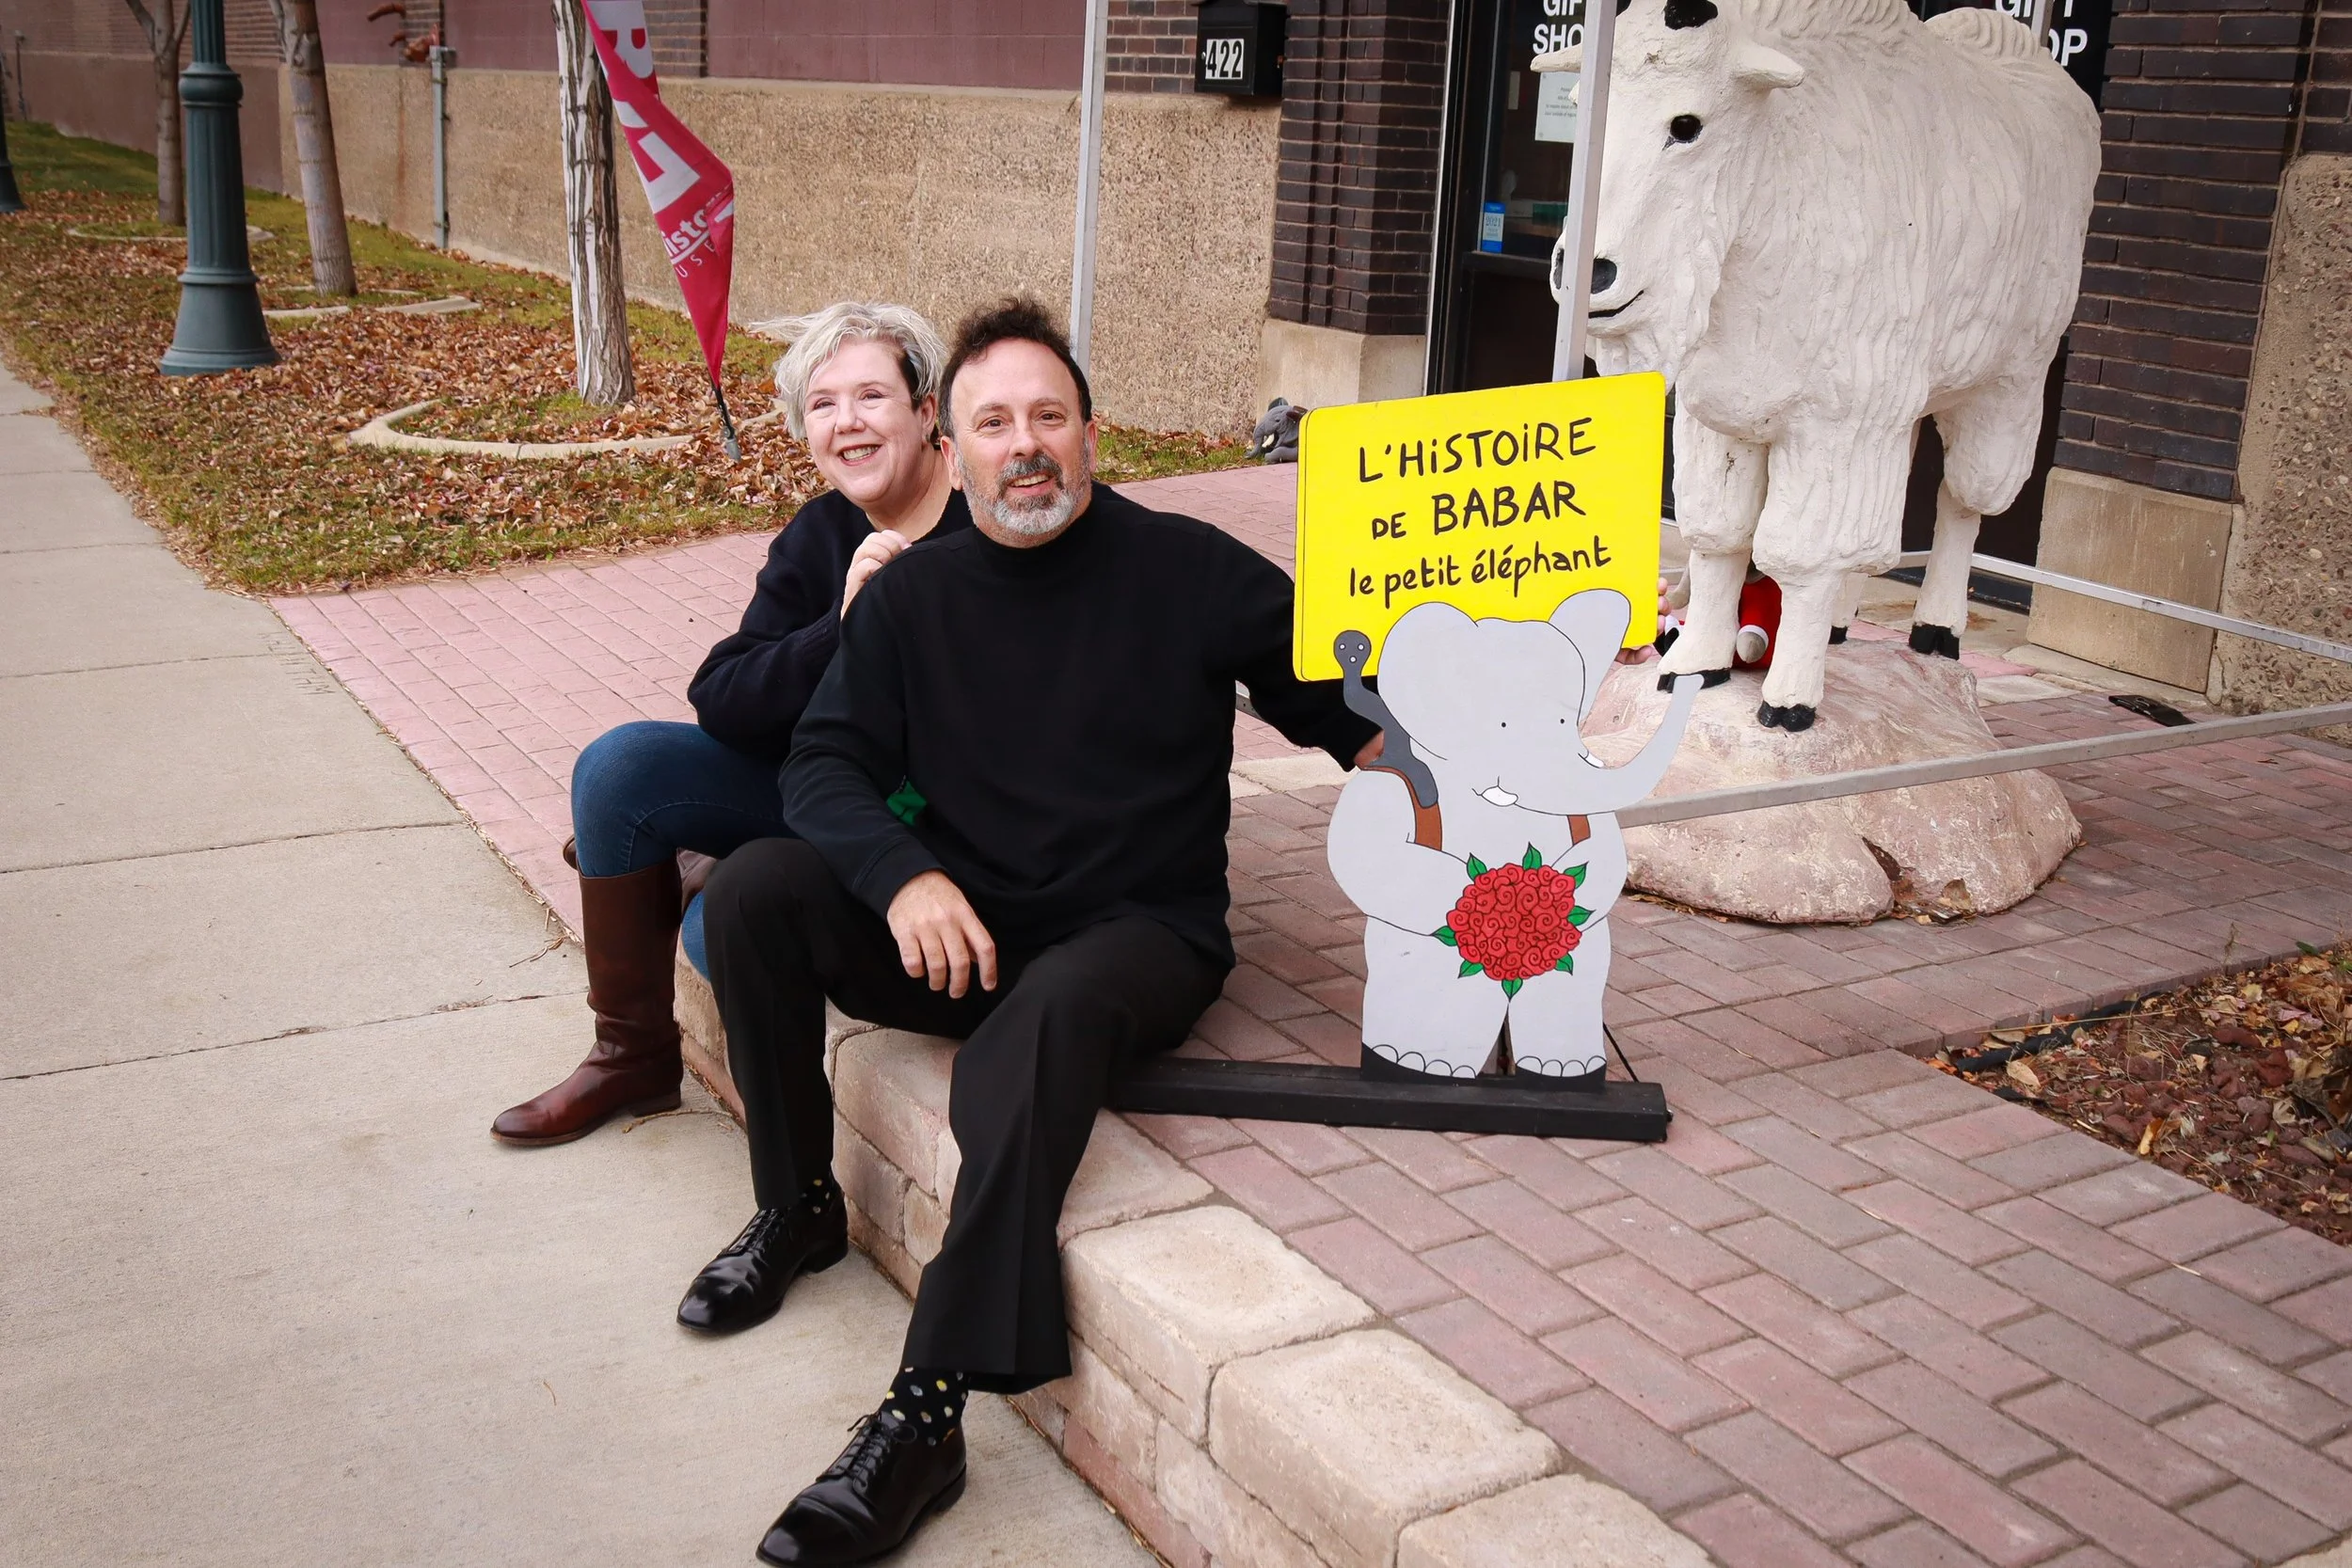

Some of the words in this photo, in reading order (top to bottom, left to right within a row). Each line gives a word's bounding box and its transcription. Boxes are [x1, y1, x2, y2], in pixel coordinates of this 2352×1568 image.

[1206, 40, 1243, 78] 422
[1533, 24, 1584, 54] SHO
[1372, 512, 1406, 540] DE
[1431, 480, 1587, 536] BABAR
[1350, 567, 1375, 597] le
[1385, 554, 1462, 610] petit
[1470, 535, 1612, 598] éléphant
